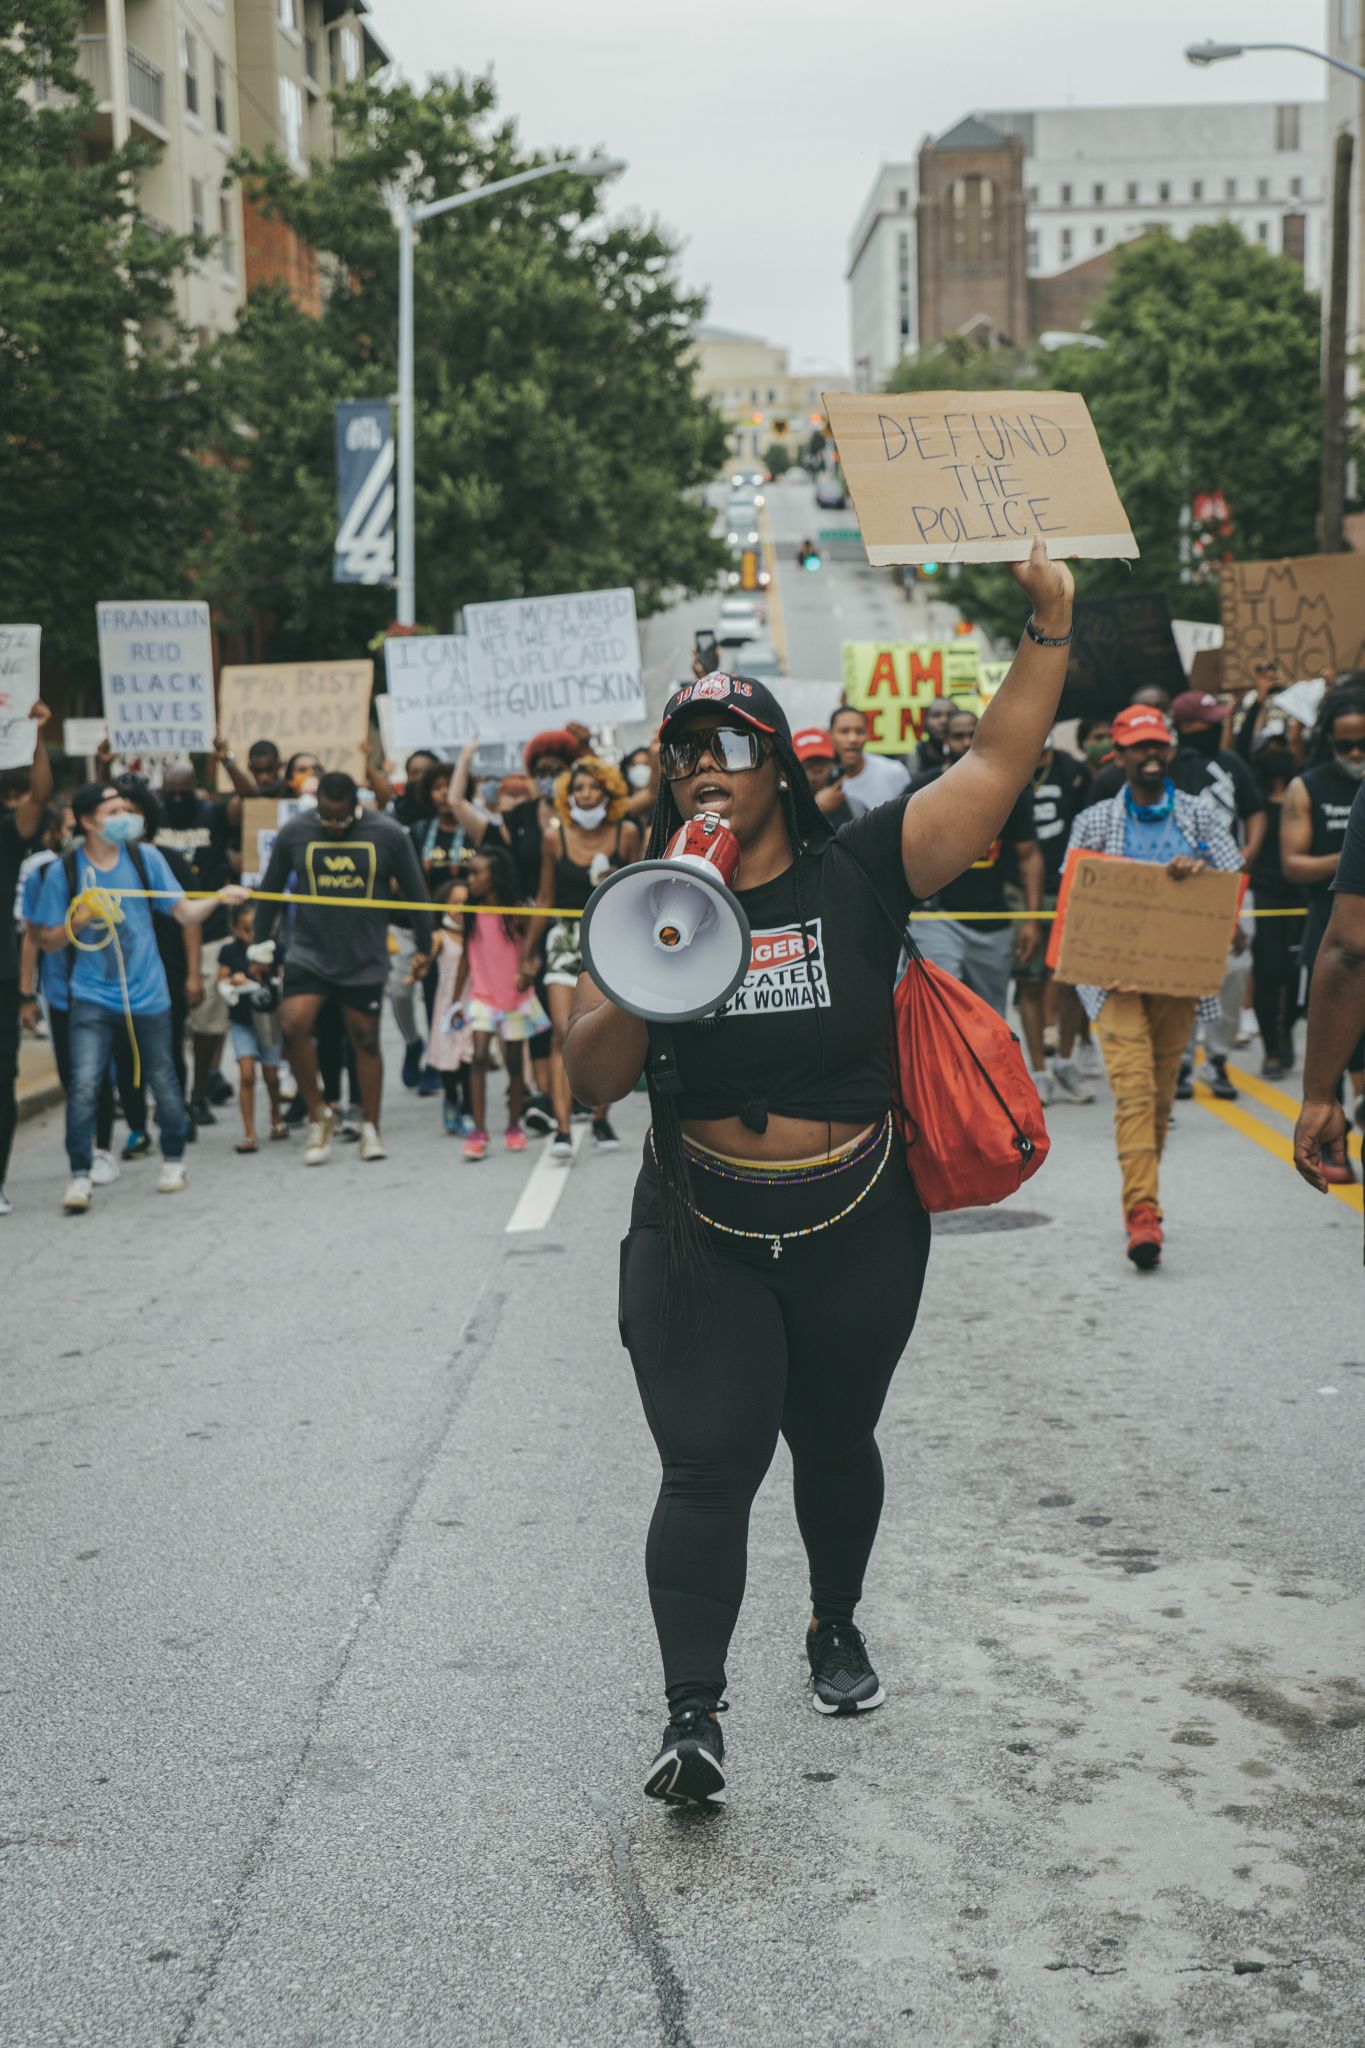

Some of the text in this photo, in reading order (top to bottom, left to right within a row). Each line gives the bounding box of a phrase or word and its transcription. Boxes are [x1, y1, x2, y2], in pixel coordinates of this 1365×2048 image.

[877, 413, 1067, 462] DEFUND
[940, 464, 1028, 502] THE
[911, 497, 1067, 544] POLICE
[101, 606, 208, 630] FRANKLIN
[470, 605, 511, 634] THE
[129, 641, 183, 663] REID
[491, 637, 627, 679] DUPLICATED
[110, 673, 204, 695] BLACK
[867, 651, 944, 697] AM
[476, 671, 641, 717] #GUILTYSKIN
[732, 679, 753, 698] 13
[118, 702, 203, 723] LIVES
[228, 704, 360, 741] APOLOGY
[114, 728, 205, 749] MATTER
[316, 874, 365, 889] RVCA
[750, 937, 807, 963] GER
[754, 985, 826, 1009] WOMAN
